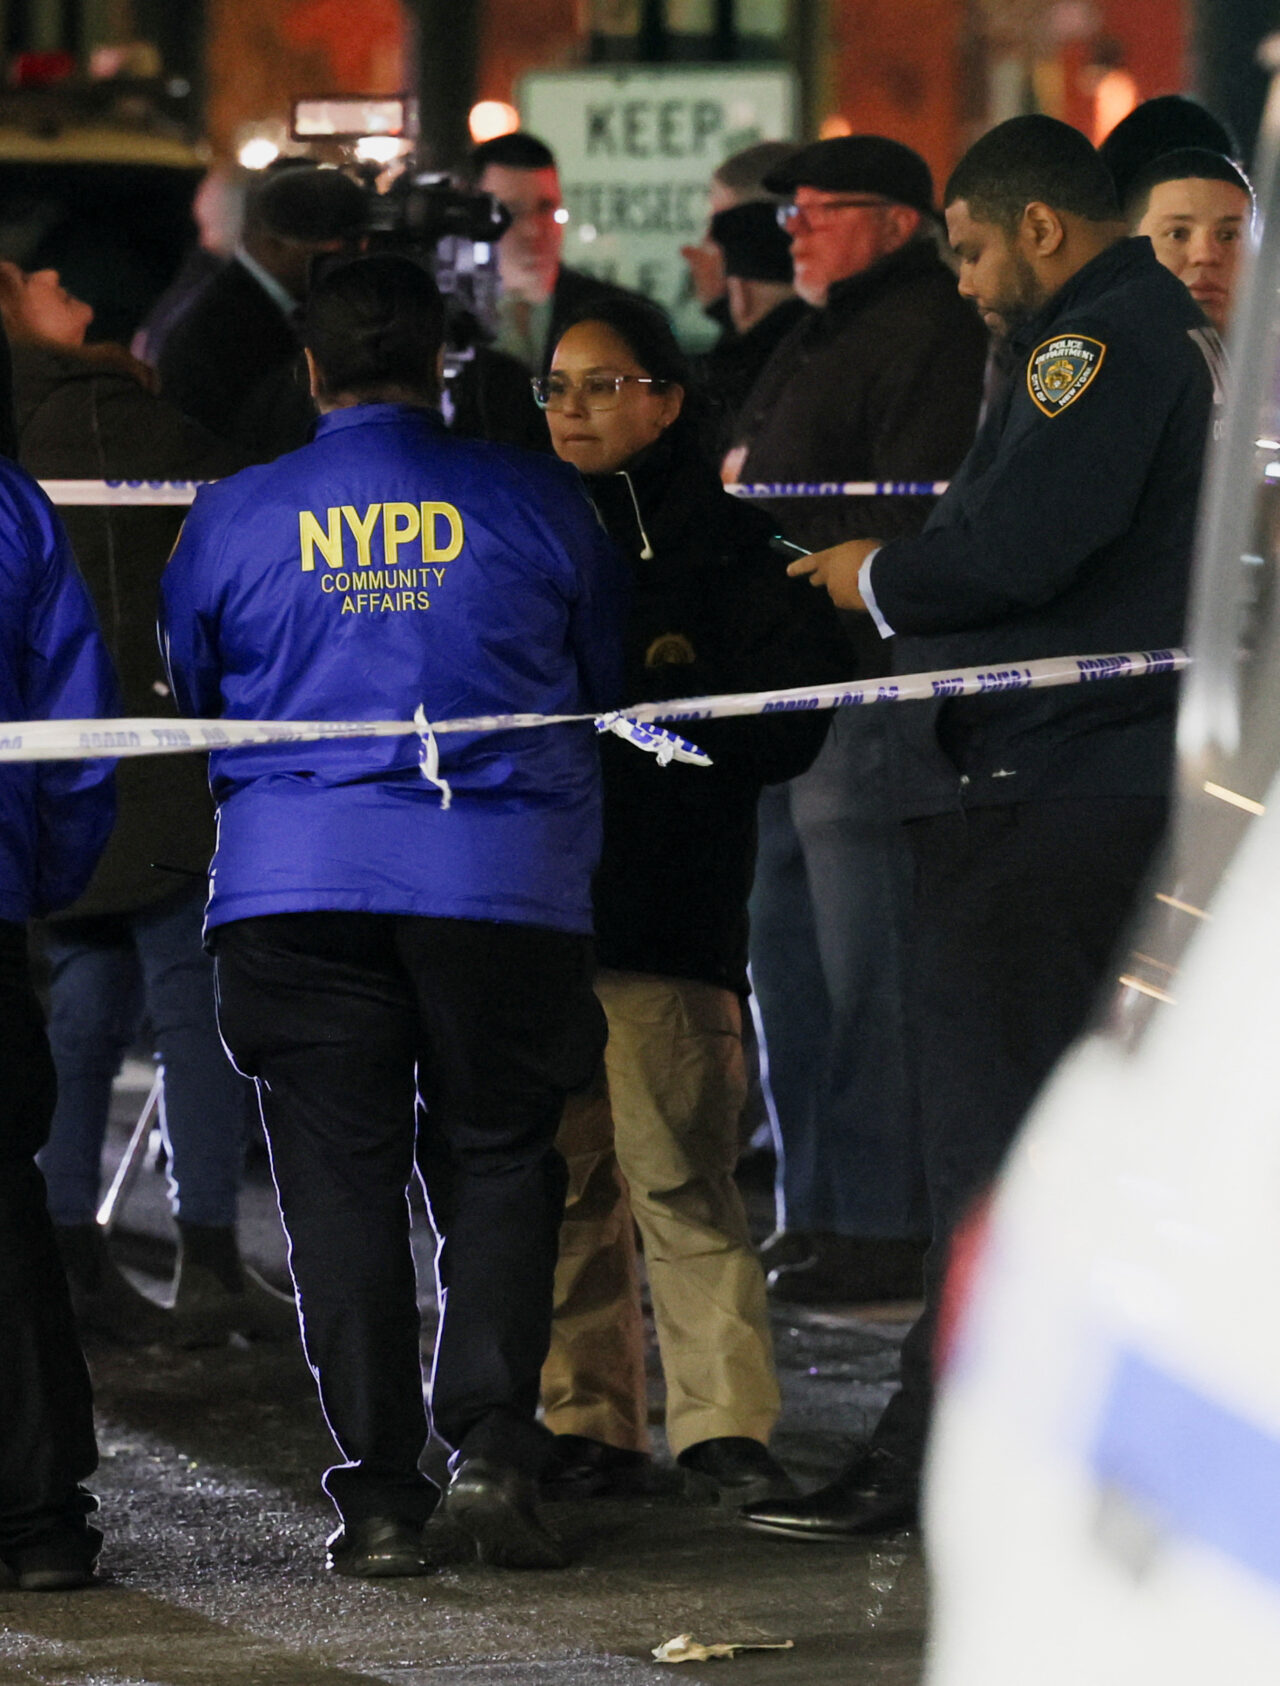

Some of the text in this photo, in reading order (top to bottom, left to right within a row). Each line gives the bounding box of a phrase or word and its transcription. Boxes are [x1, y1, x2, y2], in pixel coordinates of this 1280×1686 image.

[585, 101, 722, 156] KEEP
[1035, 348, 1094, 364] DEPARTMENT
[1049, 340, 1083, 351] POLICE
[299, 501, 464, 572] NYPD
[321, 567, 446, 593] COMMUNITY
[341, 591, 430, 615] AFFAIRS
